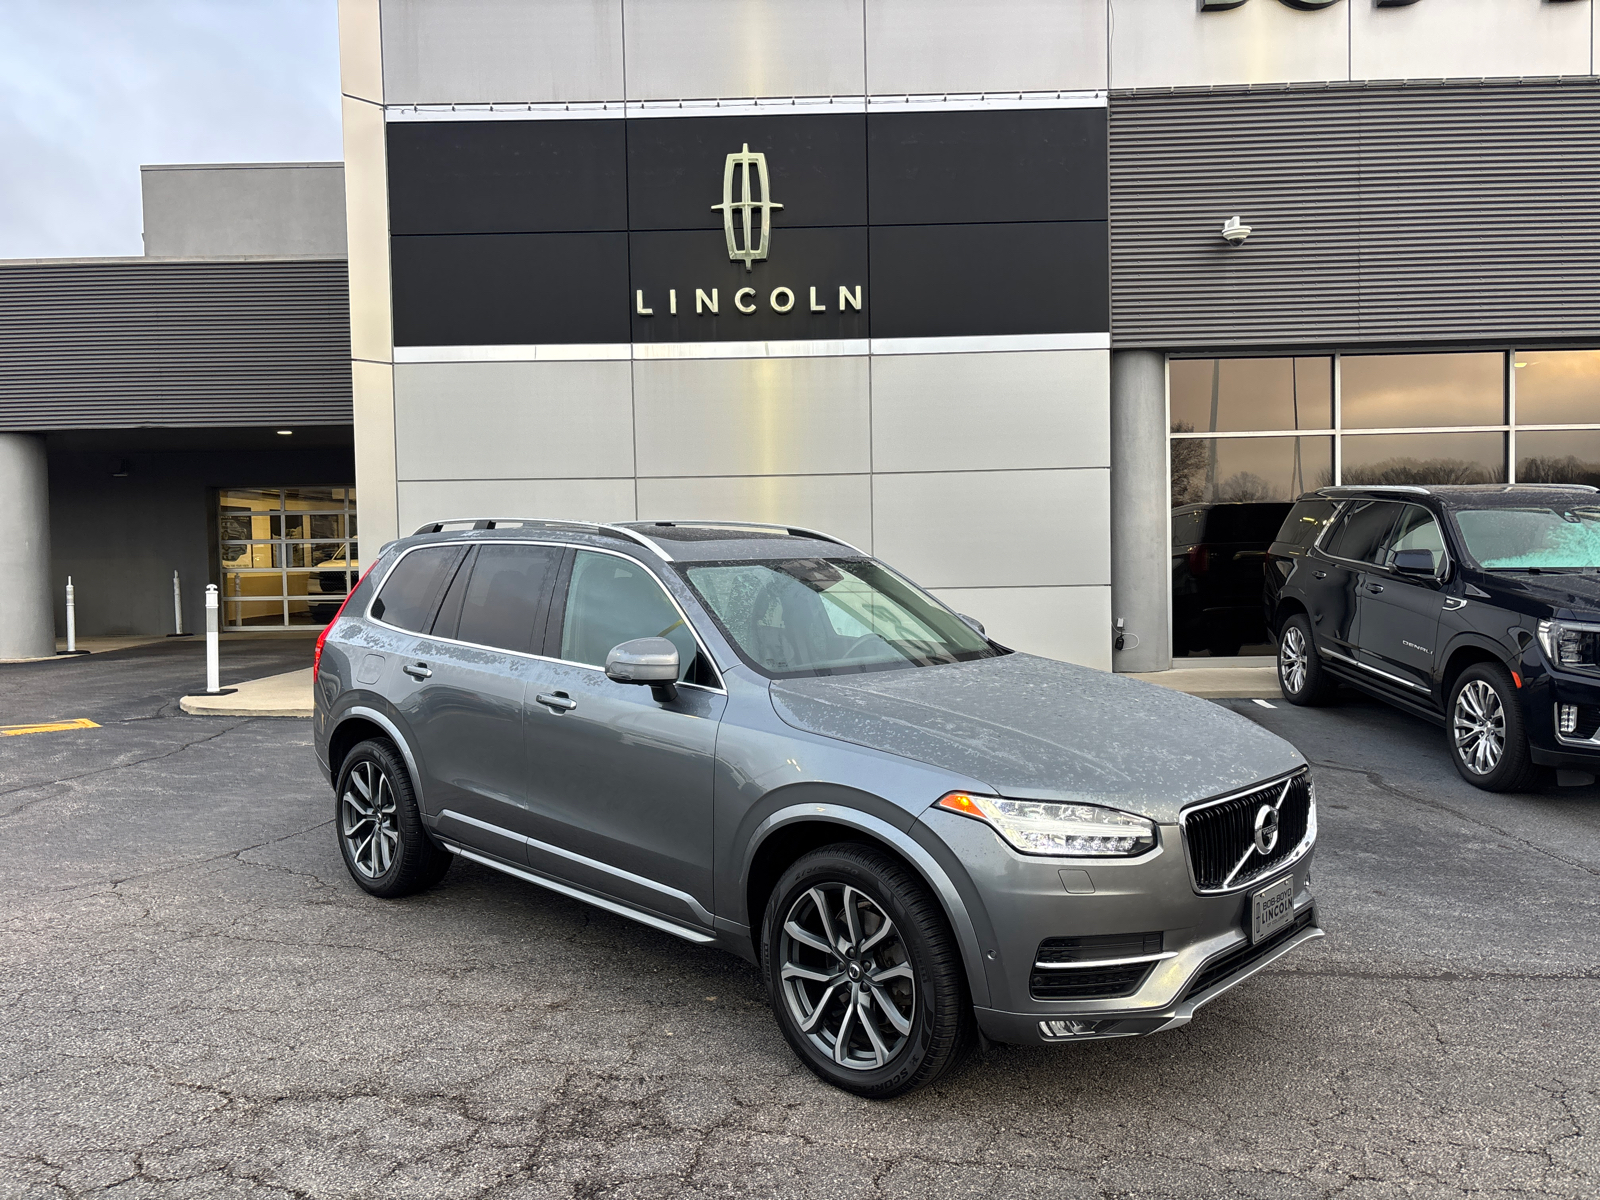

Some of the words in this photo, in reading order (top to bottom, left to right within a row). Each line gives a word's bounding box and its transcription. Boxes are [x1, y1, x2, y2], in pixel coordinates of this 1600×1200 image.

[636, 285, 862, 316] LINCOLN
[1402, 640, 1433, 655] DENALI
[1261, 896, 1293, 925] LINCOLN
